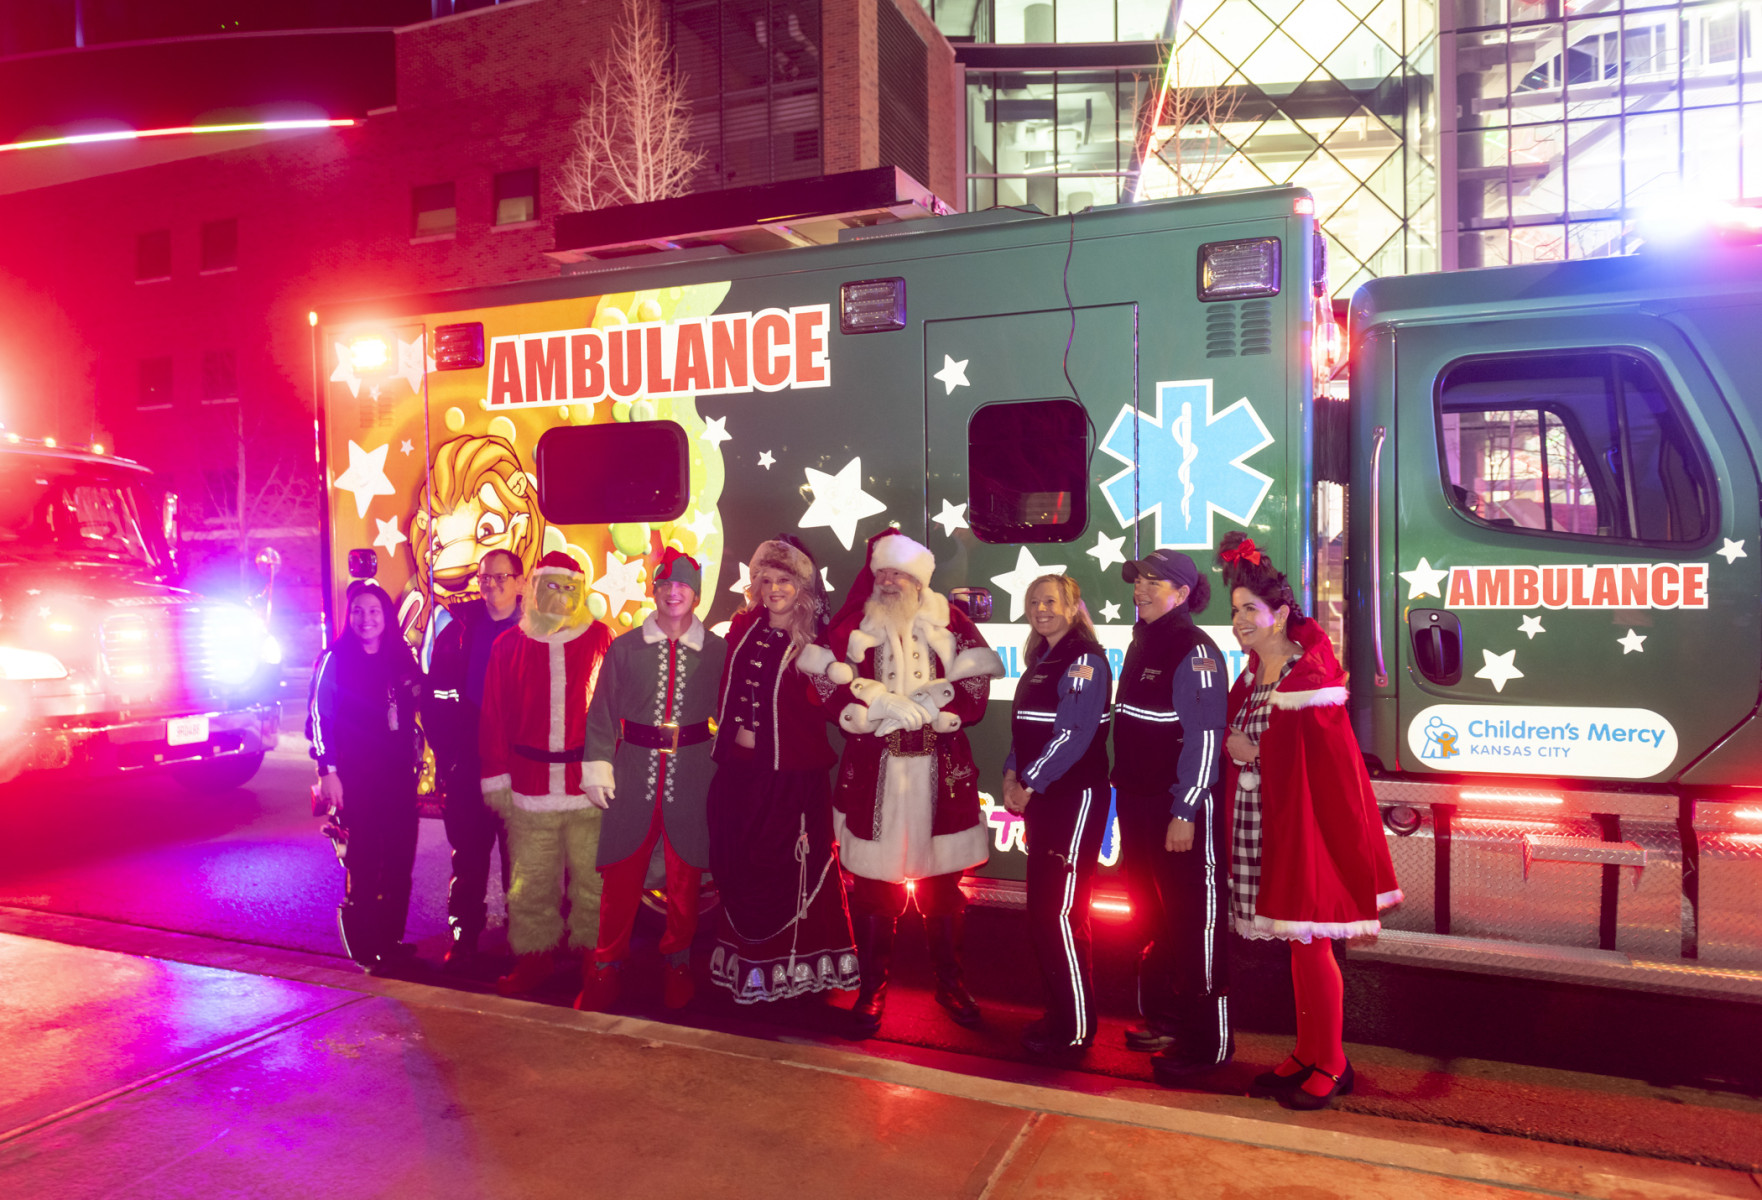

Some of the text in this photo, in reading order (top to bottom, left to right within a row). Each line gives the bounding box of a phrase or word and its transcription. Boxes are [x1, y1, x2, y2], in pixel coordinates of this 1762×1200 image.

[489, 309, 828, 407] AMBULANCE
[1447, 565, 1706, 607] AMBULANCE
[1468, 719, 1666, 748] Children's Mercy
[1470, 744, 1571, 758] KANSAS CITY
